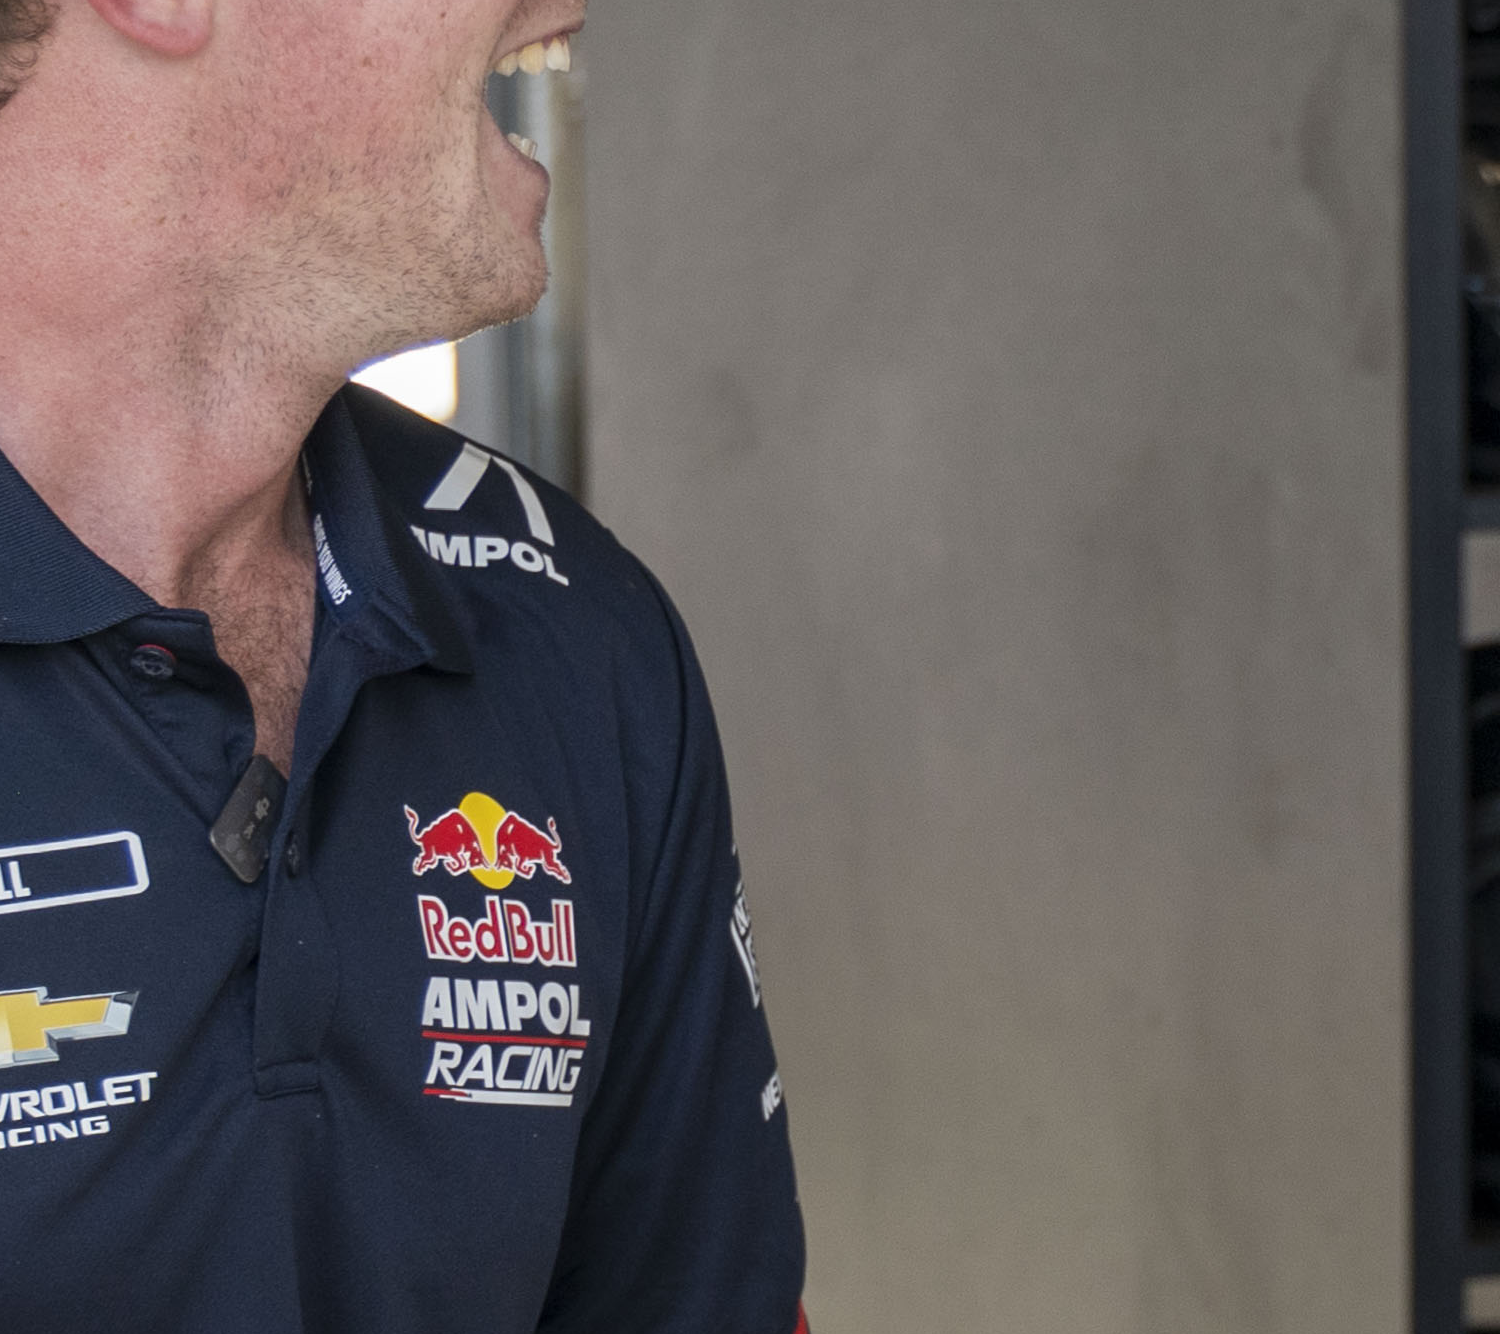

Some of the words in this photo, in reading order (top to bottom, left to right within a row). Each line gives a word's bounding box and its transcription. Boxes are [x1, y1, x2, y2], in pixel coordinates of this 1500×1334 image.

[318, 541, 336, 574] YOU
[324, 563, 353, 605] WINGS
[418, 894, 510, 963] Red
[503, 898, 578, 967] Bull
[421, 976, 592, 1037] AMPOL
[424, 1040, 584, 1093] RACING
[761, 1071, 784, 1122] NE
